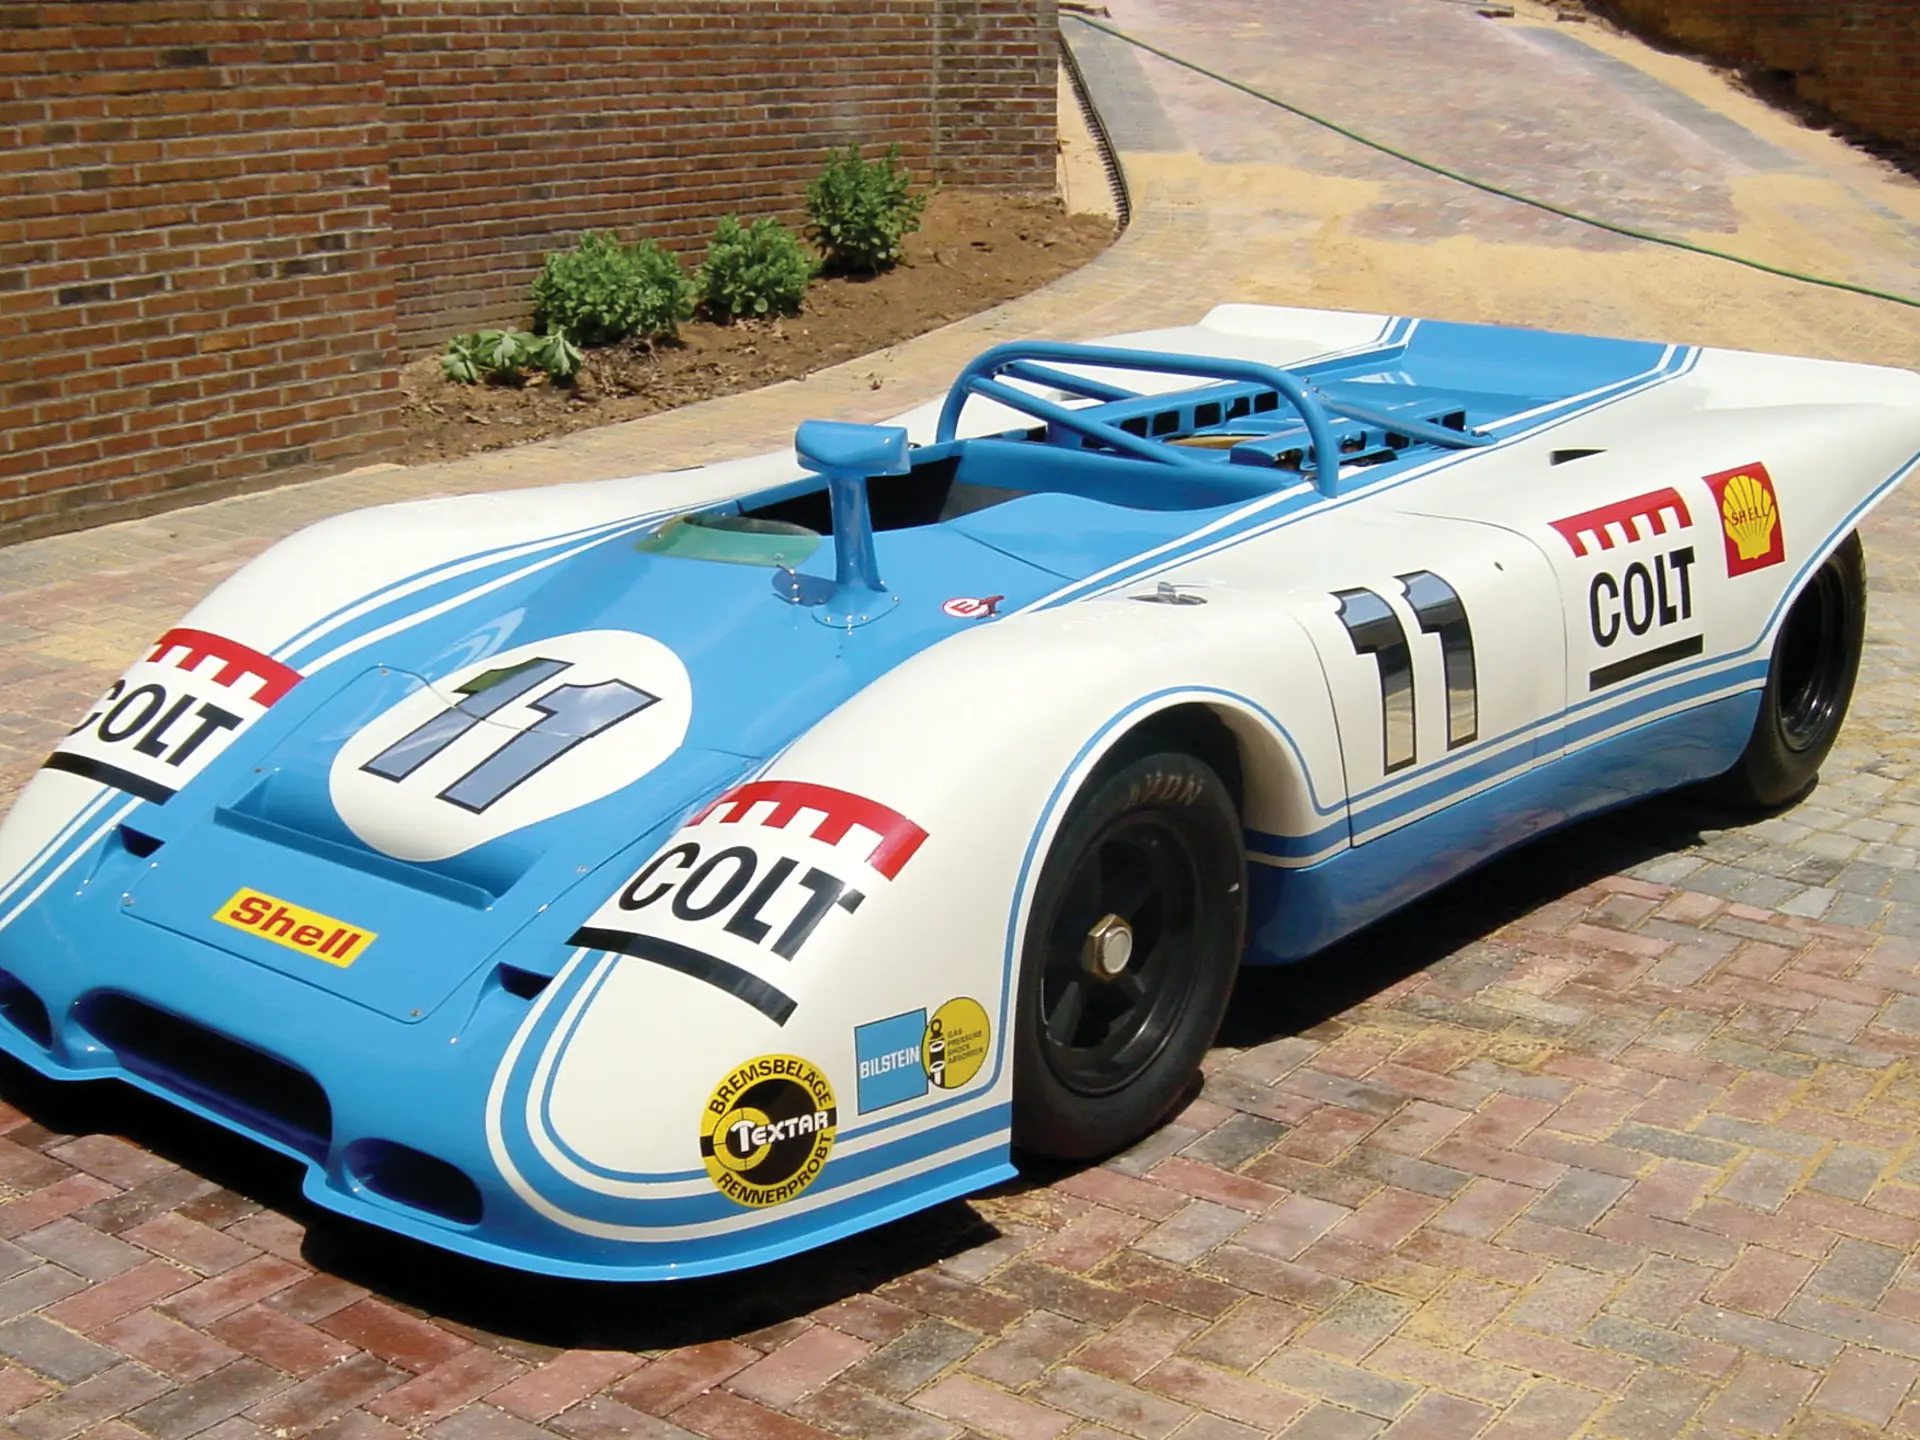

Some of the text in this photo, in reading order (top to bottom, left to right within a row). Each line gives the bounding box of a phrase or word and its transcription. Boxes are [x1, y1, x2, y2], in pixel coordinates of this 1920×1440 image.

[1731, 505, 1769, 526] SHELL
[1589, 545, 1696, 648] COLT
[1328, 568, 1479, 777] 11
[357, 656, 663, 815] 11
[229, 896, 362, 960] Shell
[617, 841, 866, 962] COLT
[708, 1058, 832, 1115] BREMSBELÄGE
[860, 1044, 921, 1079] BILSTEIN
[716, 1132, 832, 1205] RENNERPROBT
